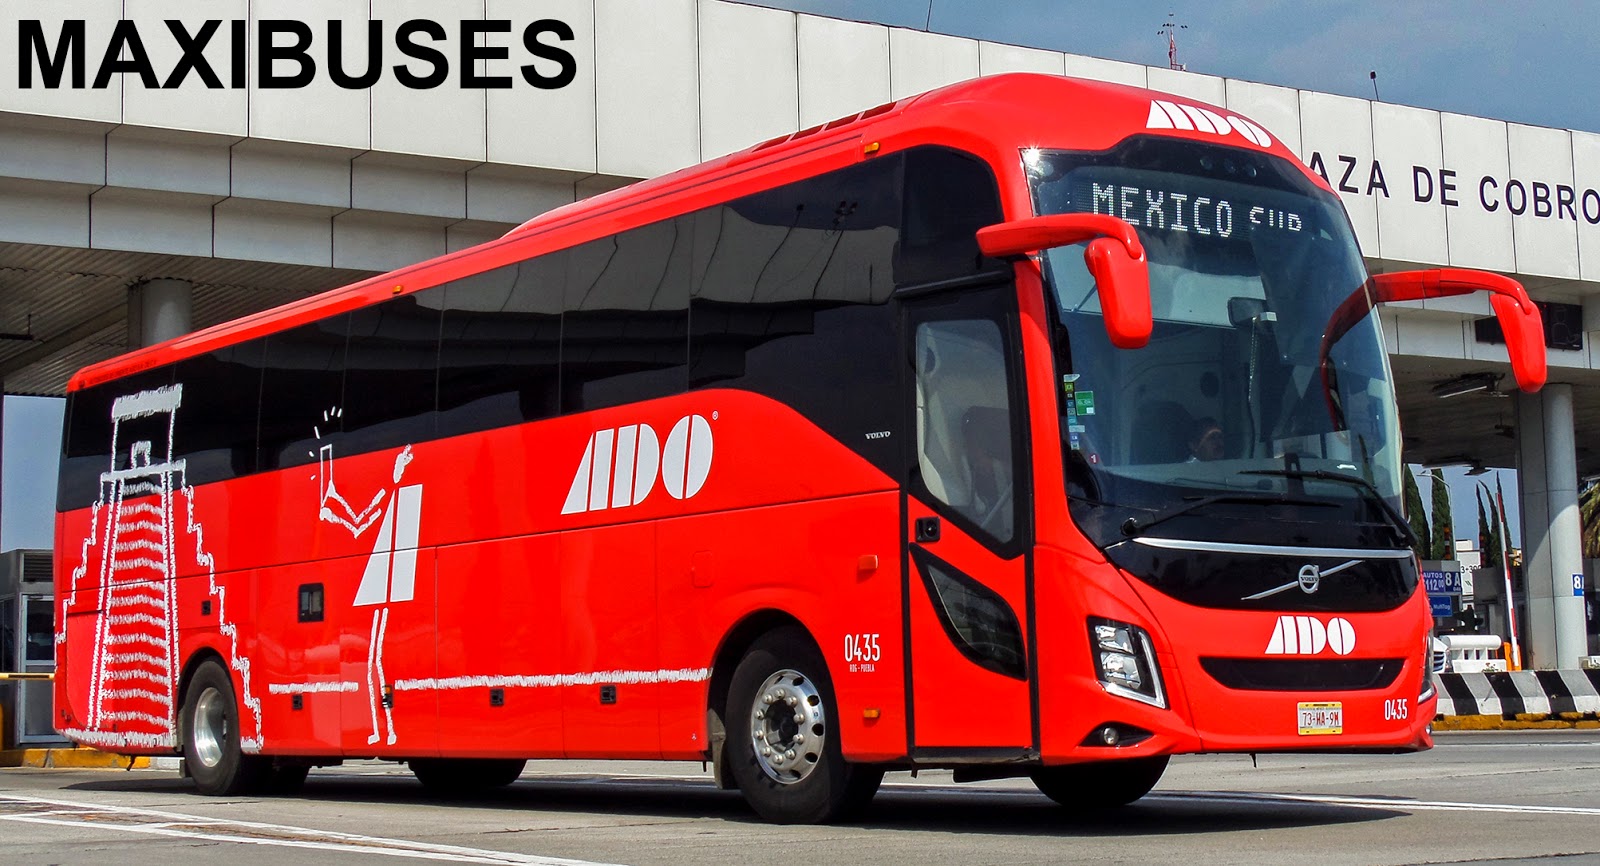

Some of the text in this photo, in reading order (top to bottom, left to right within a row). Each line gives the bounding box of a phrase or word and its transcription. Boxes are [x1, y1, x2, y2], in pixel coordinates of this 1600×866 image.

[1146, 100, 1272, 147] ADO
[1092, 182, 1232, 238] MEXICO
[1412, 165, 1459, 207] DE
[1479, 175, 1600, 225] COBRO
[865, 431, 891, 440] VOLVO
[561, 414, 714, 515] ADO
[1445, 572, 1461, 587] 8 A
[844, 633, 881, 662] 0435
[1265, 616, 1356, 656] ADO
[1384, 698, 1408, 720] 0435
